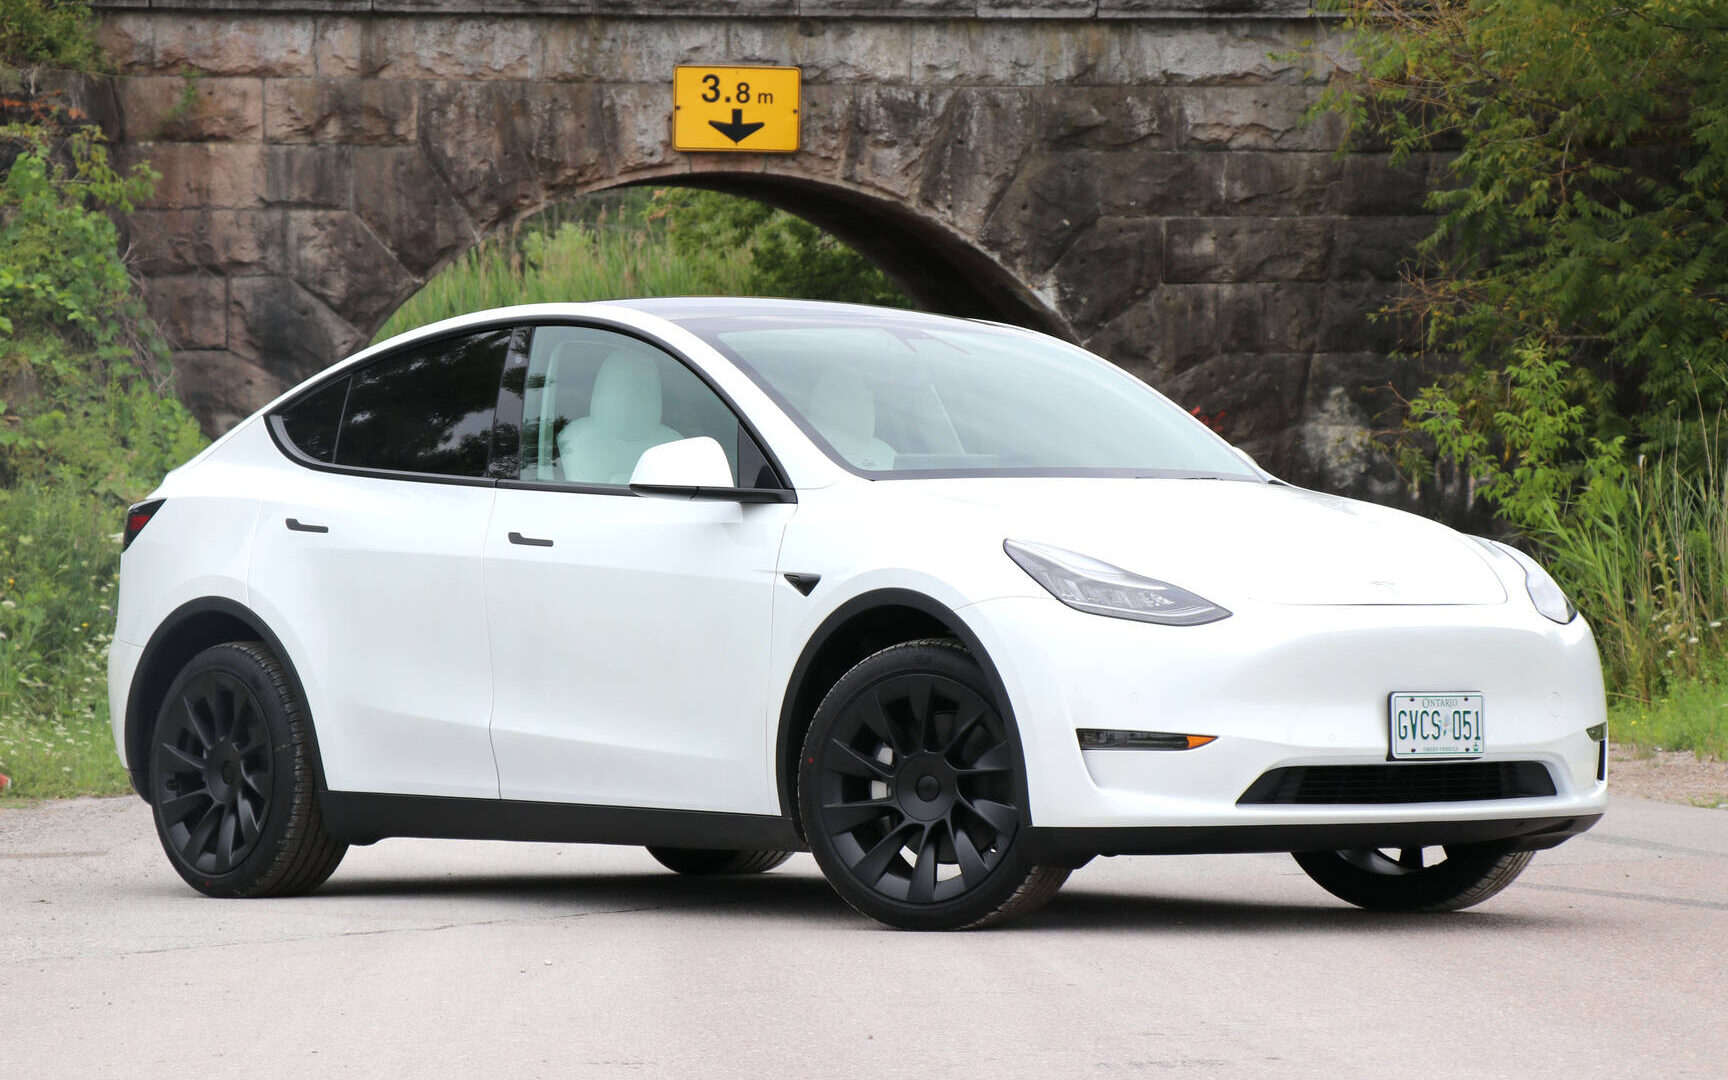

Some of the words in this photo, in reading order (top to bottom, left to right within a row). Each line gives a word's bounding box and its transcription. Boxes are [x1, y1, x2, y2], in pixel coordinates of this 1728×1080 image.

[701, 73, 750, 104] 3.8
[757, 92, 774, 104] m
[1422, 698, 1458, 708] ONTARIO
[1398, 710, 1441, 740] GVCS
[1452, 710, 1481, 740] 051
